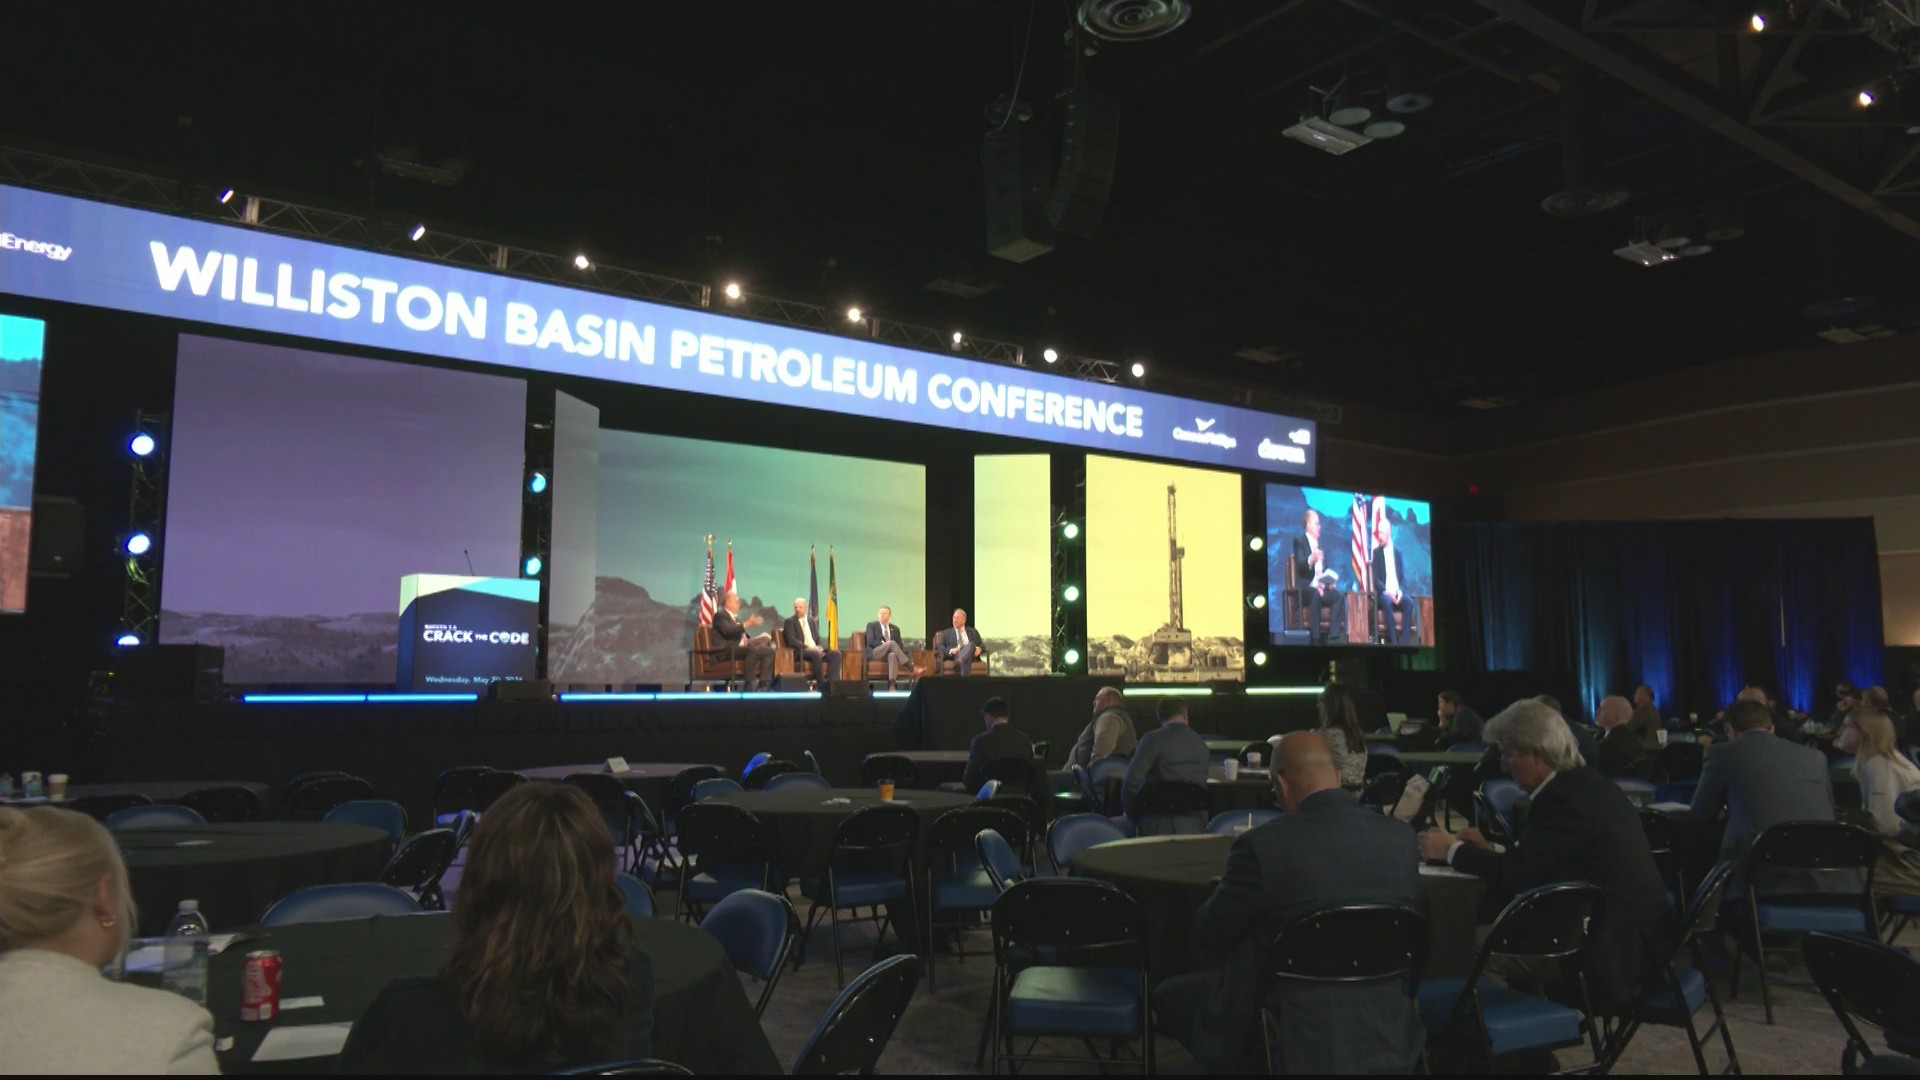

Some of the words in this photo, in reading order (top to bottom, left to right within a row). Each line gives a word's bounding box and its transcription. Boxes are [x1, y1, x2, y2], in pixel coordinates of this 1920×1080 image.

[149, 241, 488, 340] WILLISTON
[504, 301, 656, 366] BASIN
[669, 329, 918, 405] PETROLEUM
[927, 373, 1144, 438] CONFERENCE
[423, 630, 474, 643] CRACK
[489, 631, 530, 645] CODE
